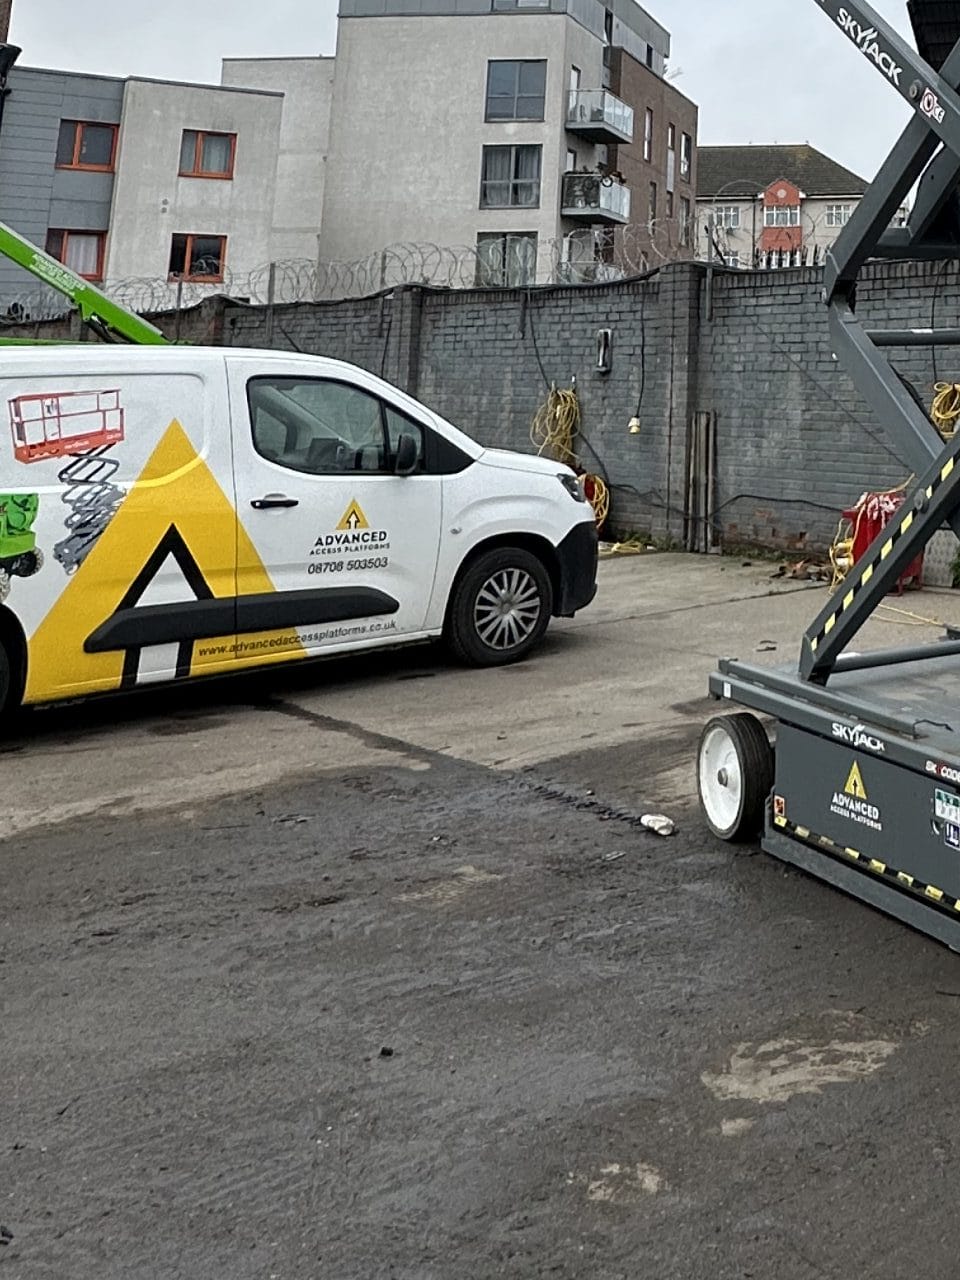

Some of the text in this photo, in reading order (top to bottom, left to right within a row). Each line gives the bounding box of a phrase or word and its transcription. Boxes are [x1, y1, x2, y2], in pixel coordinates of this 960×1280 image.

[836, 7, 903, 86] SKYJACK
[310, 542, 391, 556] ACCESS PLATFORMS
[314, 531, 388, 547] ADVANCED
[346, 557, 388, 571] 503503
[198, 619, 397, 656] www.advancedaccessplatforms.co.uk
[832, 792, 880, 820] ADVANCED
